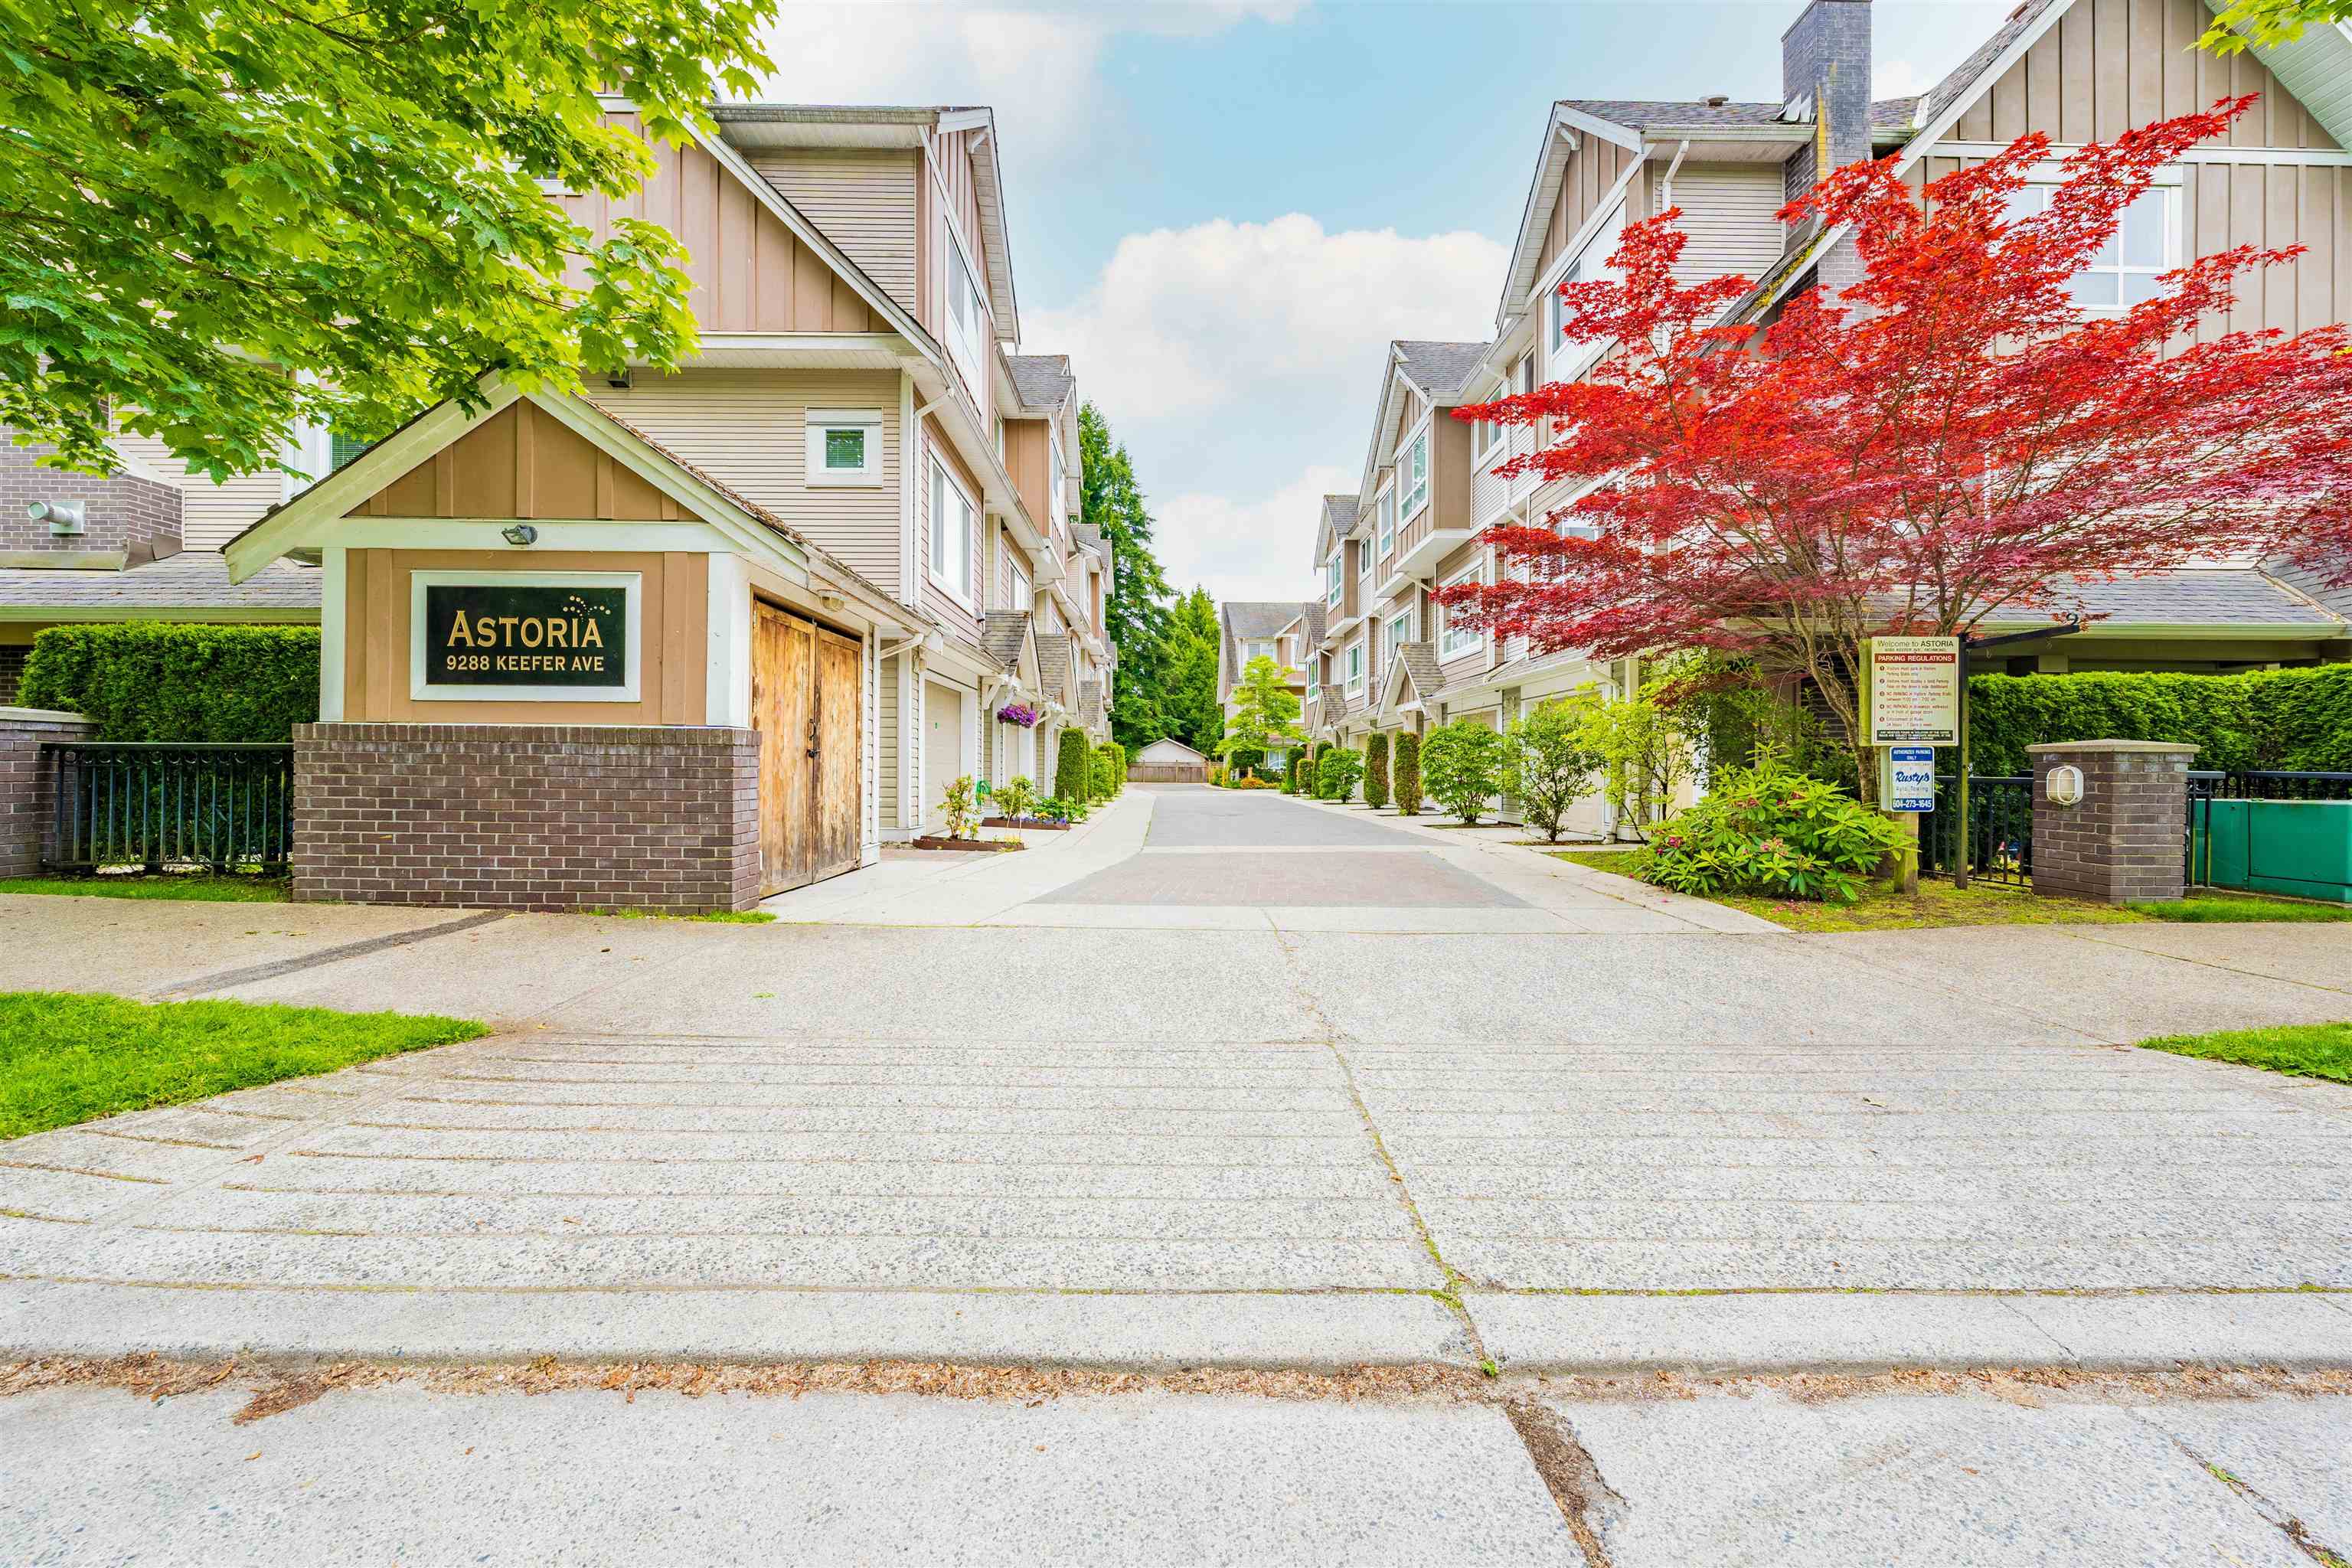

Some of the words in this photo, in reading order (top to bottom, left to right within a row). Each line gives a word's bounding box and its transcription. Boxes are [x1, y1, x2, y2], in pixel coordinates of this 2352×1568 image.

[446, 610, 604, 648] ASTORIA
[446, 655, 490, 671] 9288
[496, 655, 566, 671] KEEFER
[571, 656, 604, 671] AVE
[1895, 771, 1930, 785] Rusty's
[1893, 799, 1932, 808] 604-273-1645
